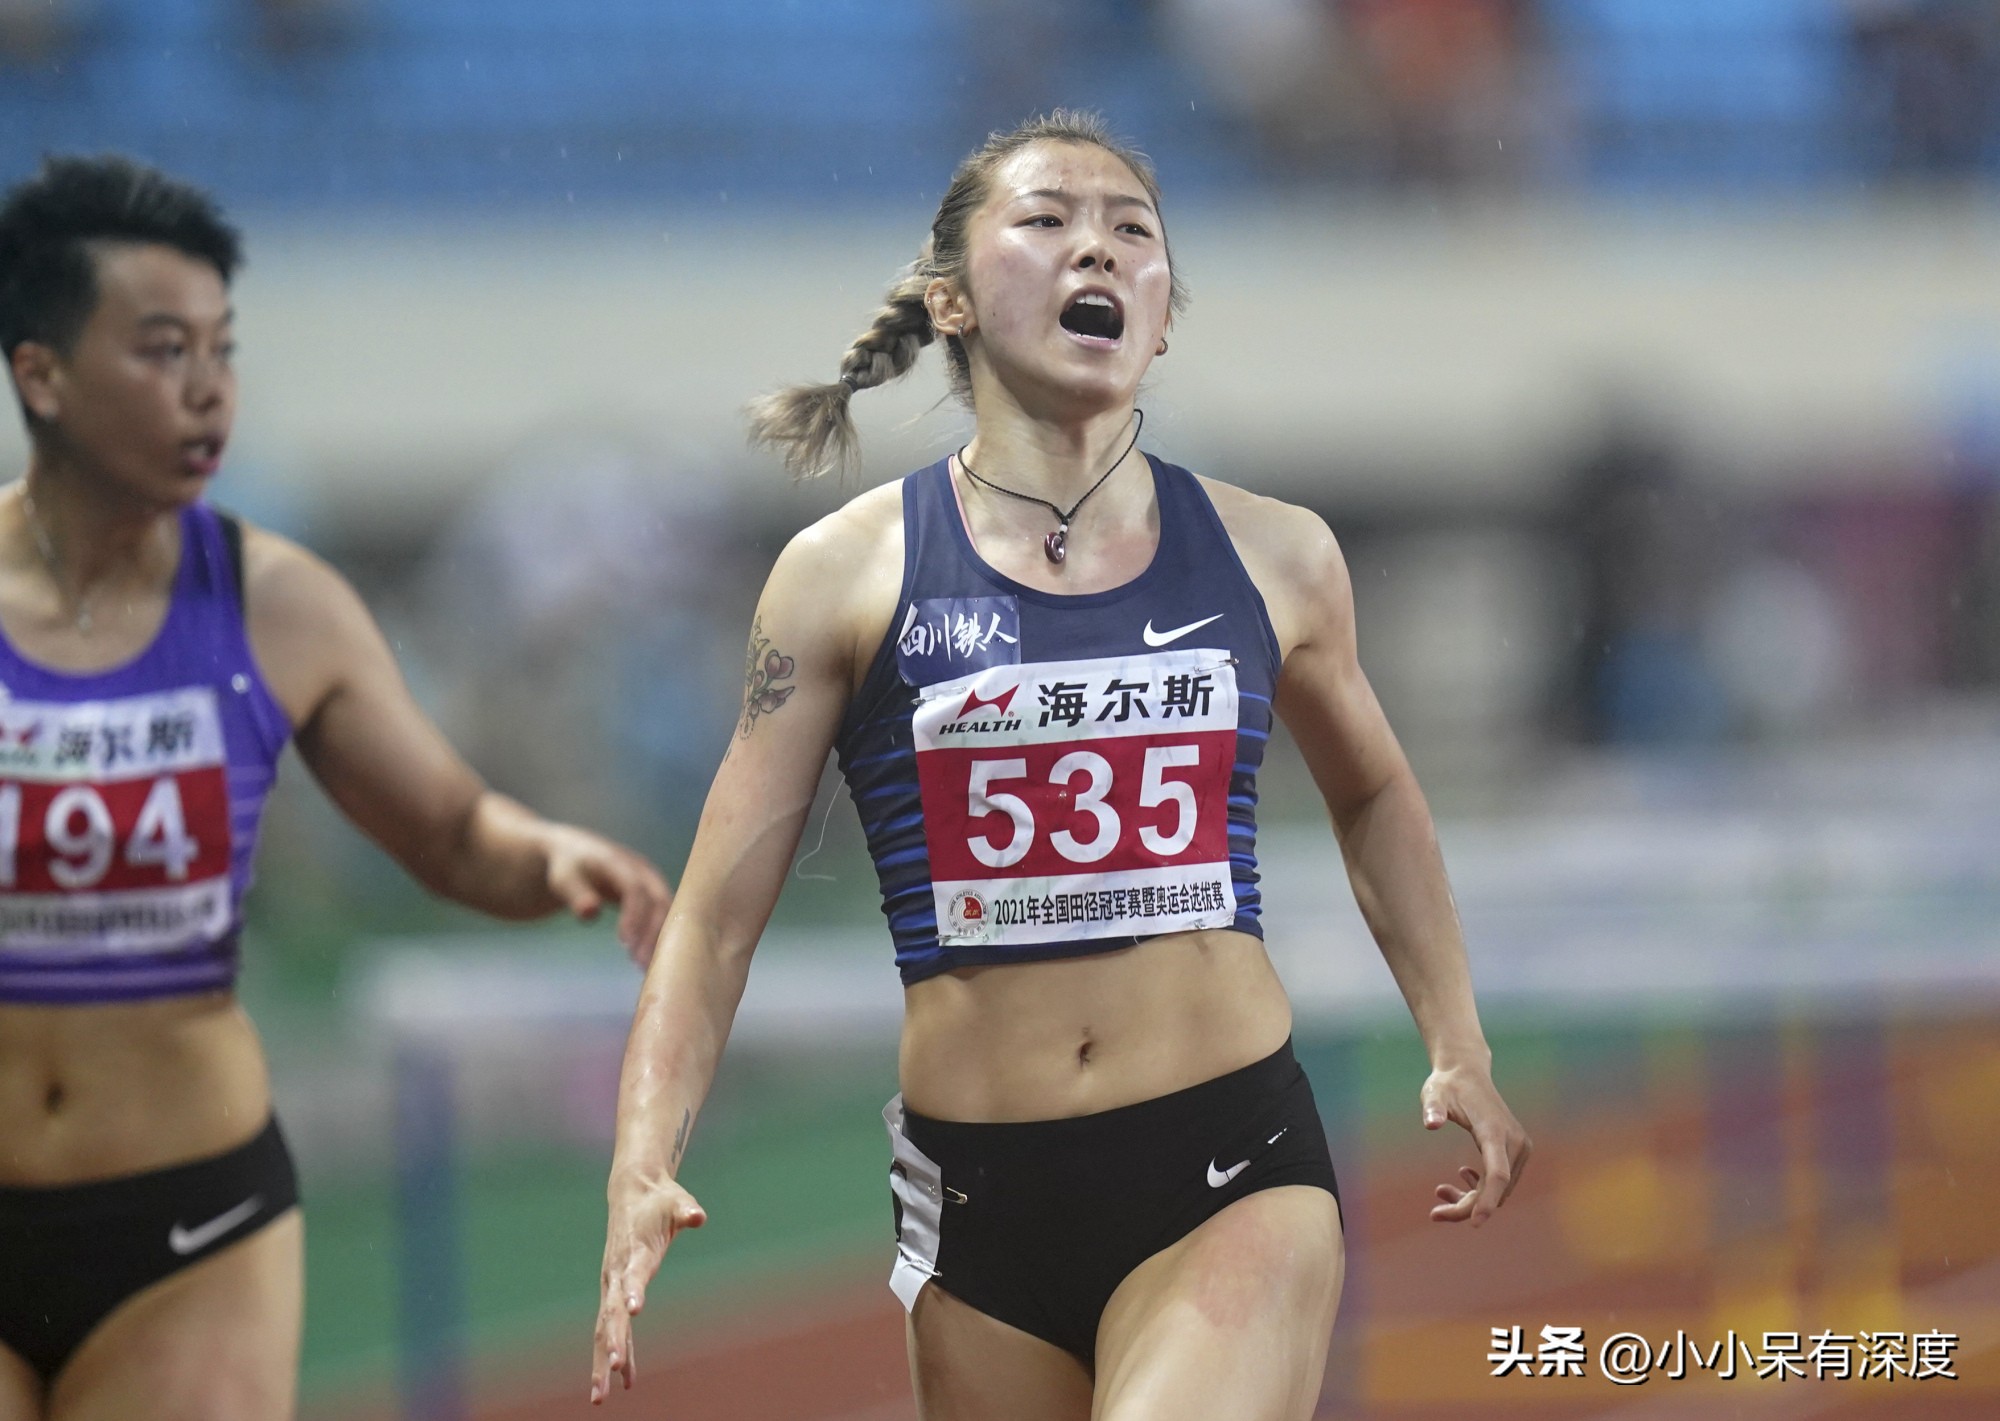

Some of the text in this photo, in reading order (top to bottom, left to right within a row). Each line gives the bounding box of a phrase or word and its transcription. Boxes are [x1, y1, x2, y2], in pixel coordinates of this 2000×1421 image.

[899, 611, 1018, 662] 四川铁人
[939, 719, 1022, 735] HEALTH
[1038, 674, 1214, 728] 海尔斯
[0, 775, 199, 888] 194
[967, 744, 1200, 868] 535
[994, 880, 1226, 927] 2021年全国田径冠军赛暨奥运会选拔赛
